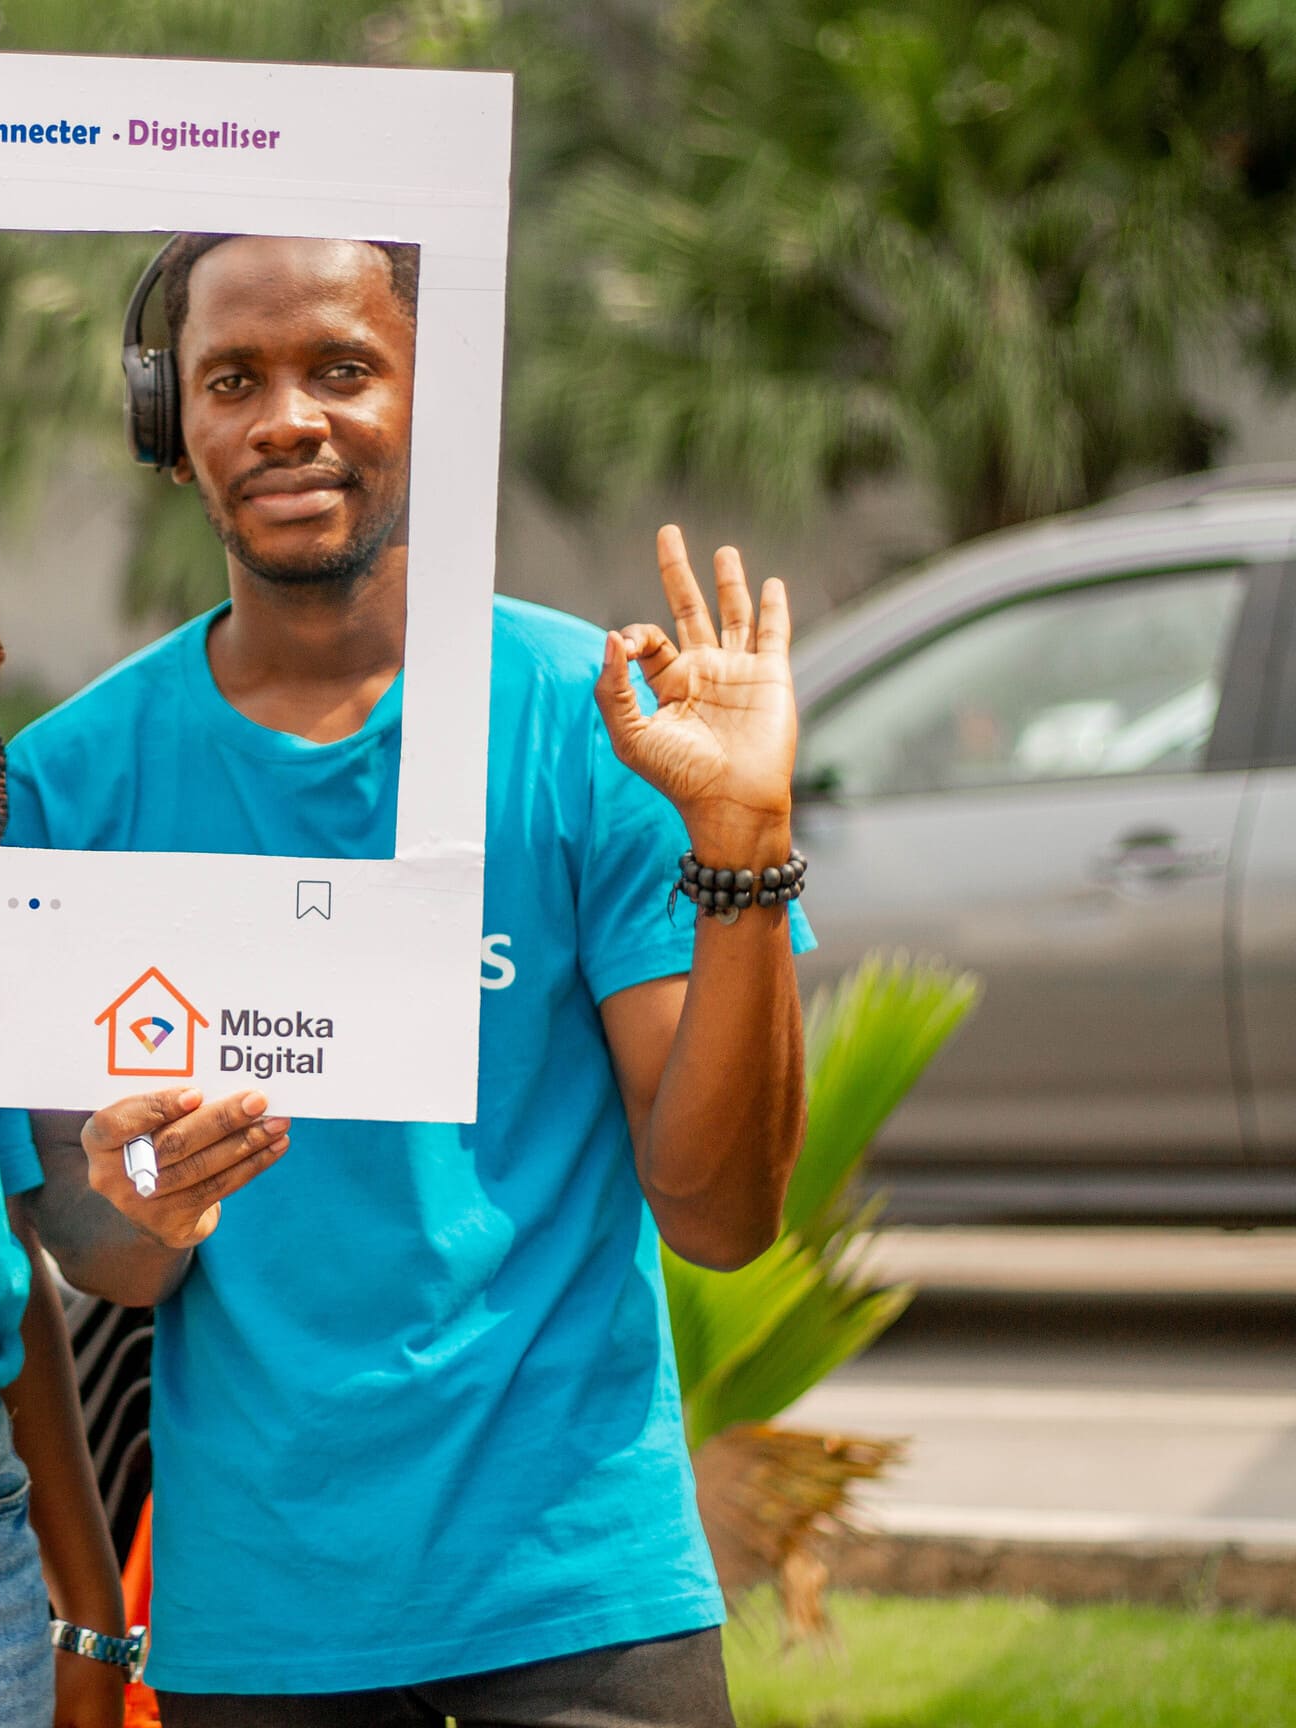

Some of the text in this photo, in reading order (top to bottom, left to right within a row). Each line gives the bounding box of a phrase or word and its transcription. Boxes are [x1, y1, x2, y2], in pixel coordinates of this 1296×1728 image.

[127, 118, 281, 152] Digitaliser
[219, 1008, 335, 1039] Mboka
[219, 1044, 324, 1080] Digital
